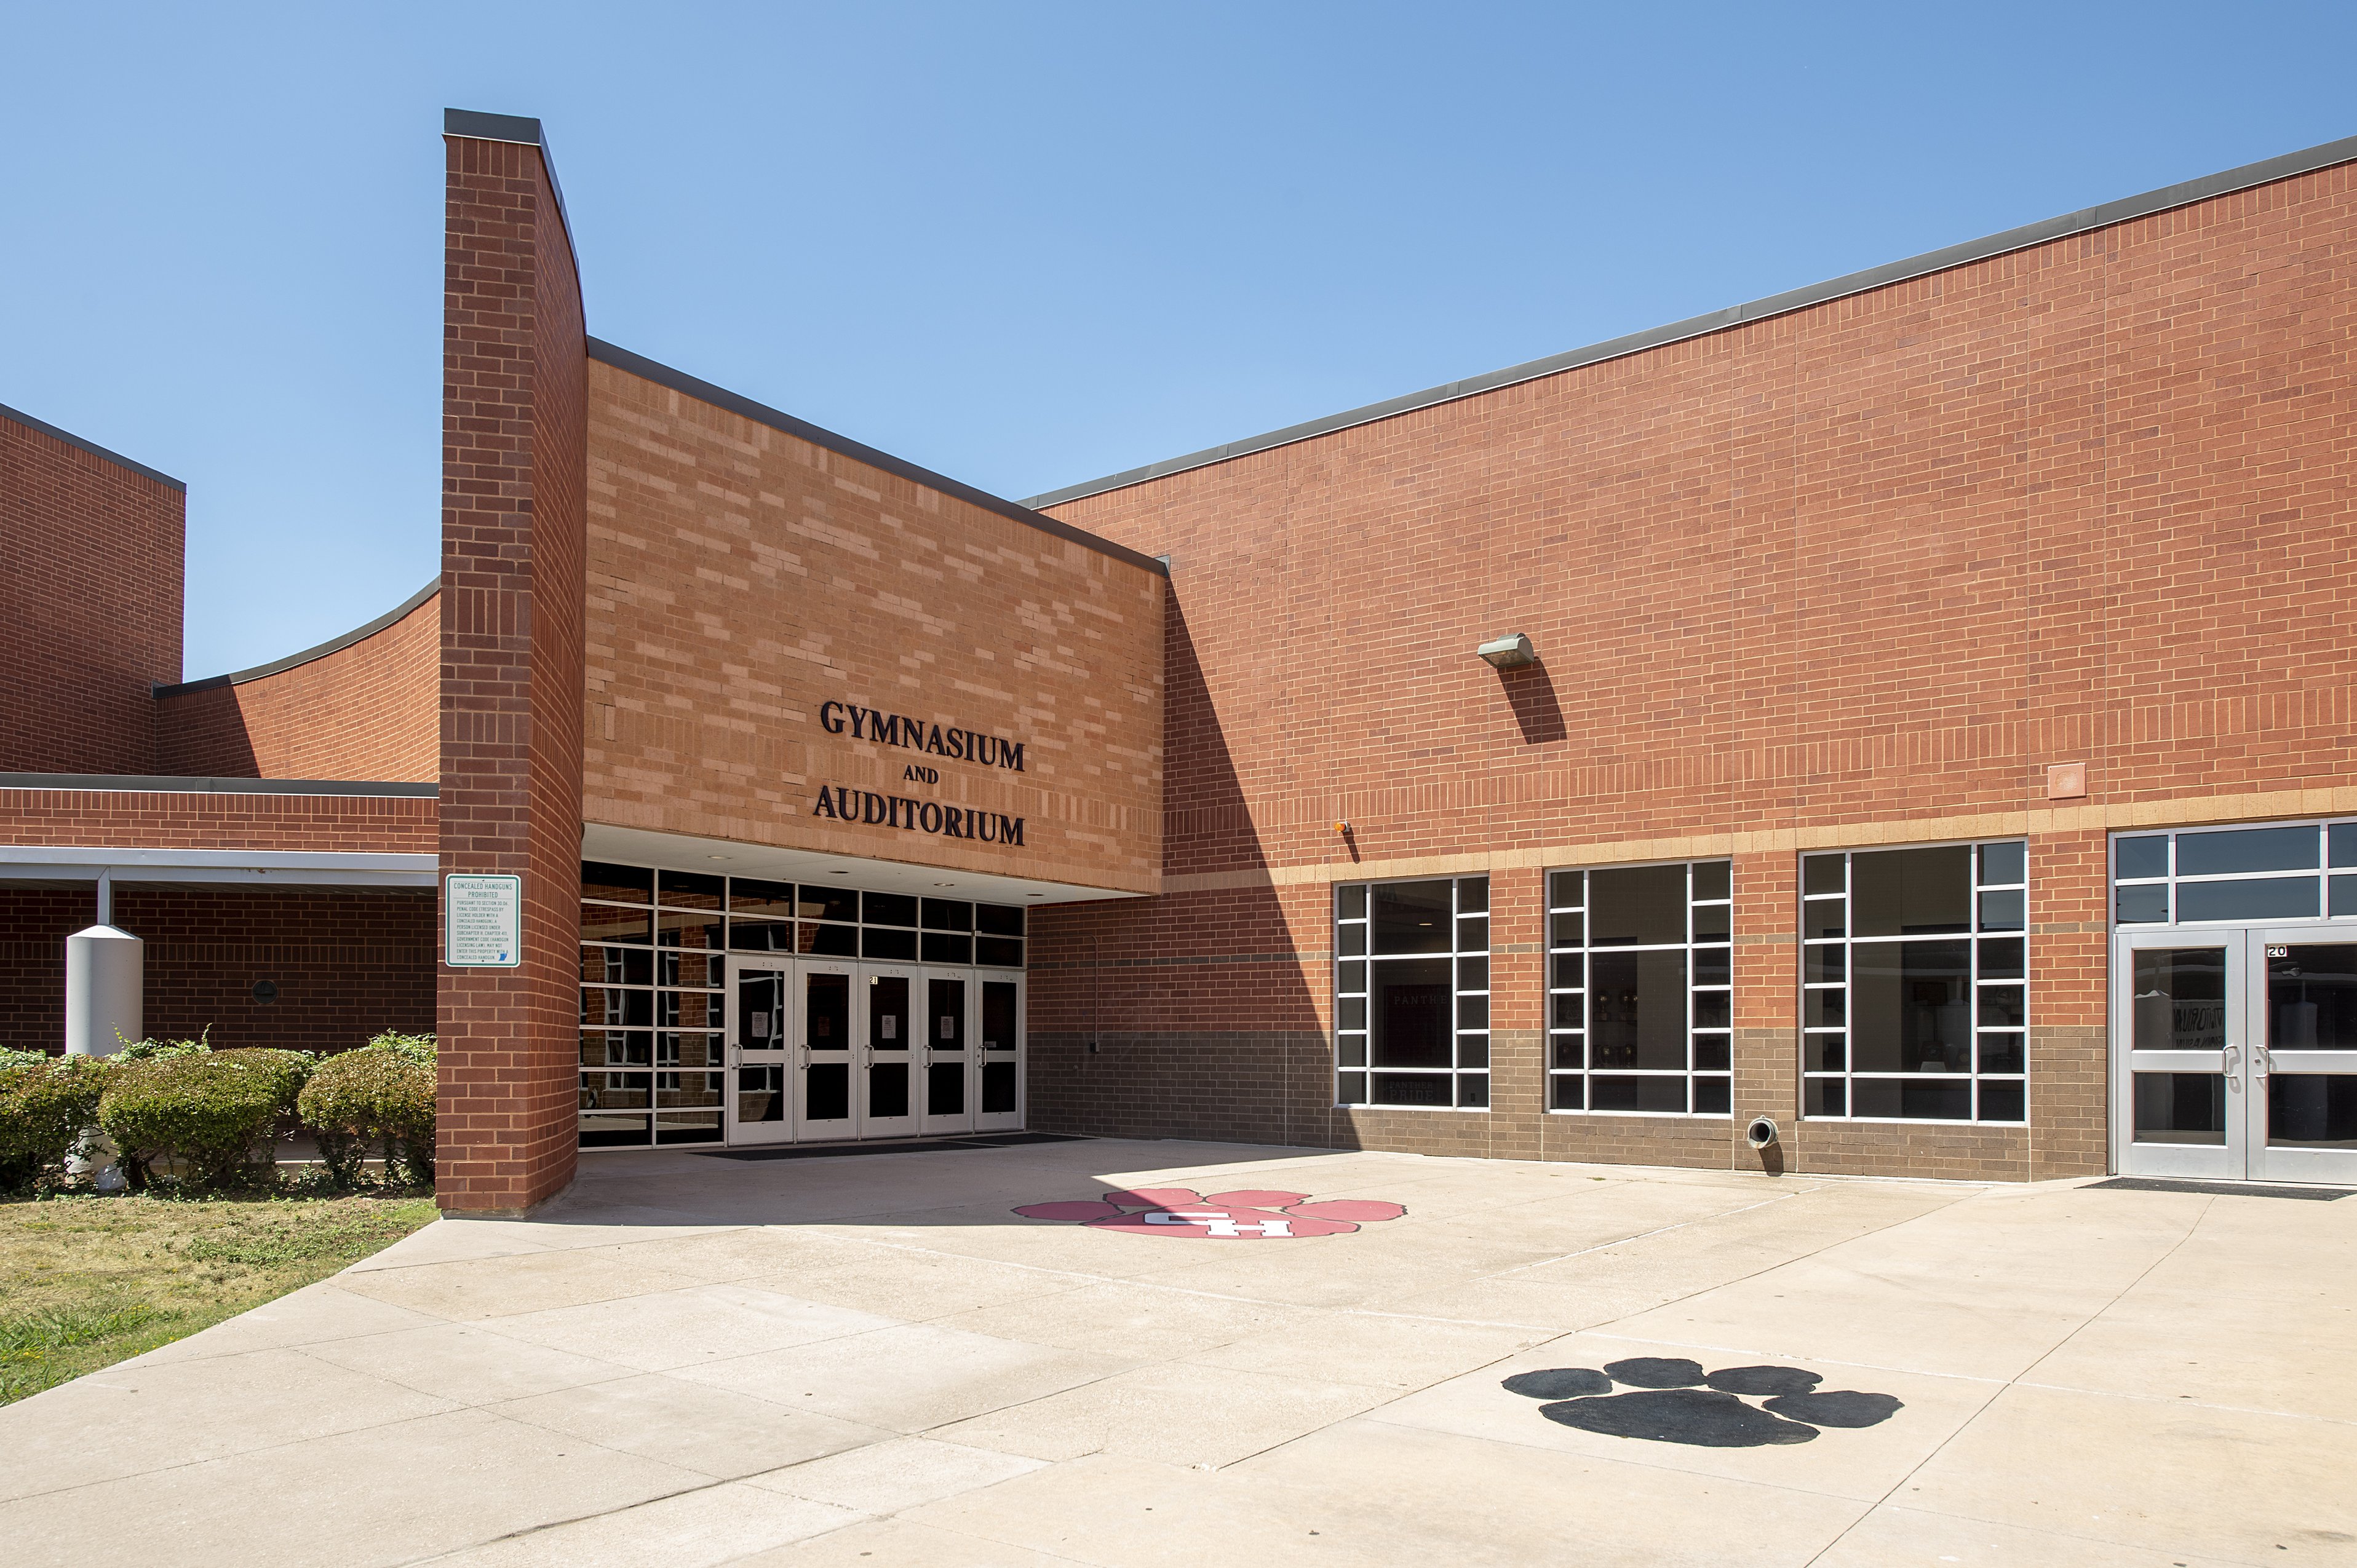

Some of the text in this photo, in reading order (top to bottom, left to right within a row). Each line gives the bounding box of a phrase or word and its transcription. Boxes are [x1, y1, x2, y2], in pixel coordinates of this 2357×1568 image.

[821, 700, 1025, 772] GYMNASIUM
[903, 765, 939, 784] AND
[813, 785, 1025, 846] AUDITORIUM
[2269, 946, 2286, 956] 20
[1389, 1090, 1433, 1101] PRIDE
